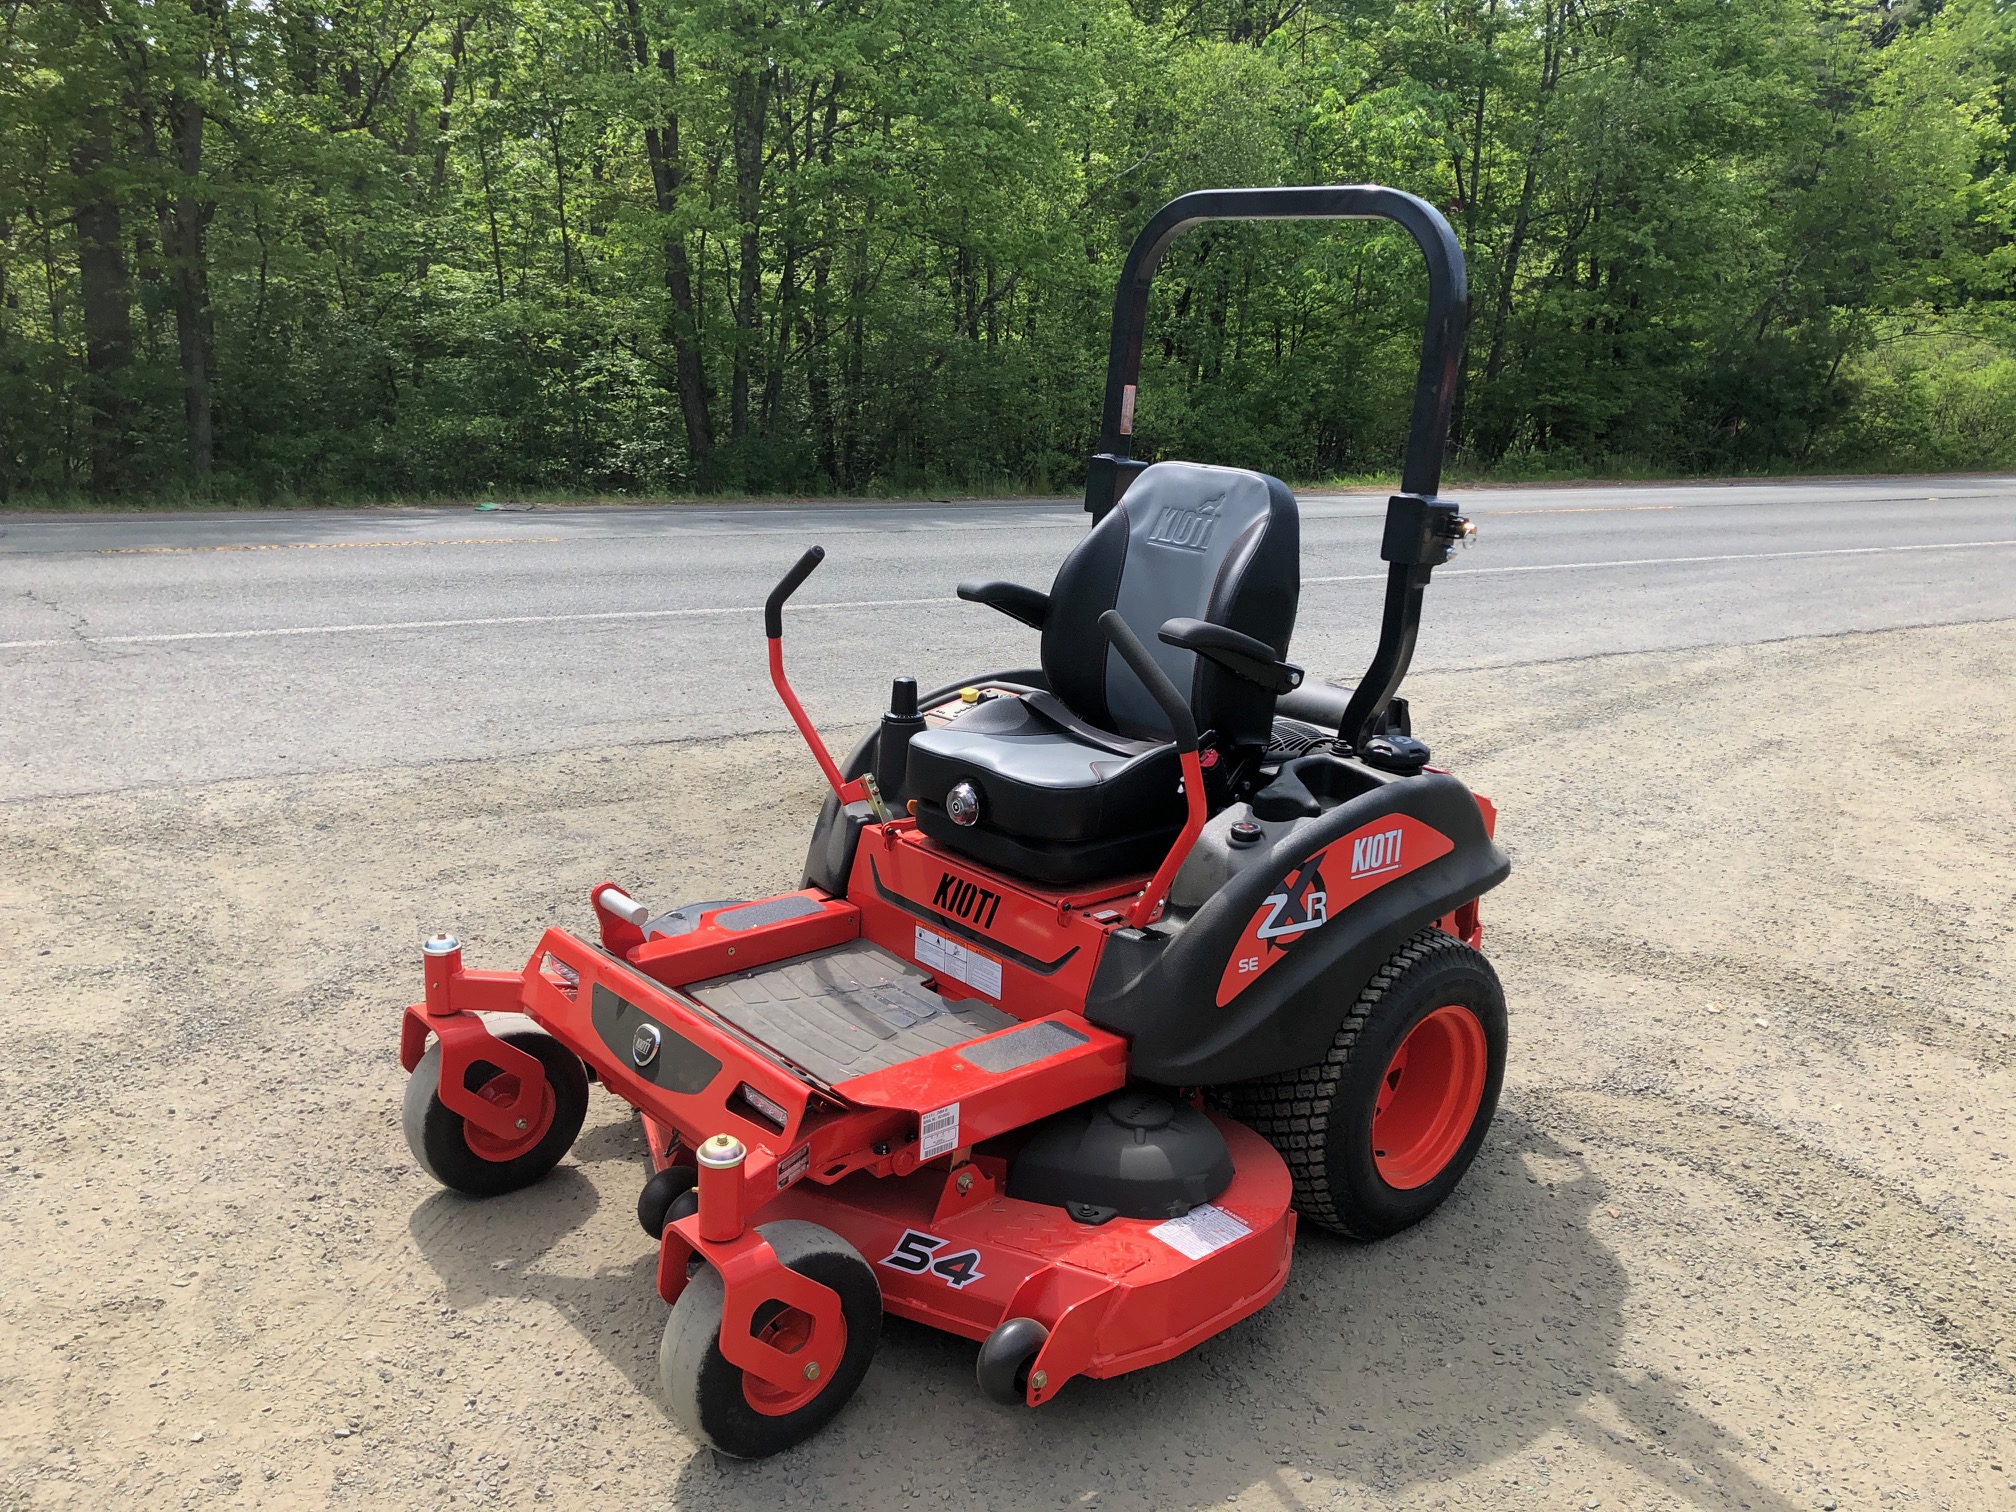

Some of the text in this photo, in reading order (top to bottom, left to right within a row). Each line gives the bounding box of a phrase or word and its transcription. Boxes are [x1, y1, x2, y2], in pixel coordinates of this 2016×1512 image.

[1149, 506, 1221, 549] KIOTI
[1351, 828, 1403, 874] KIOTI
[932, 871, 1001, 930] KIOTI
[1238, 956, 1259, 973] SE
[1223, 1209, 1249, 1225] DANGER
[879, 1229, 984, 1290] 54
